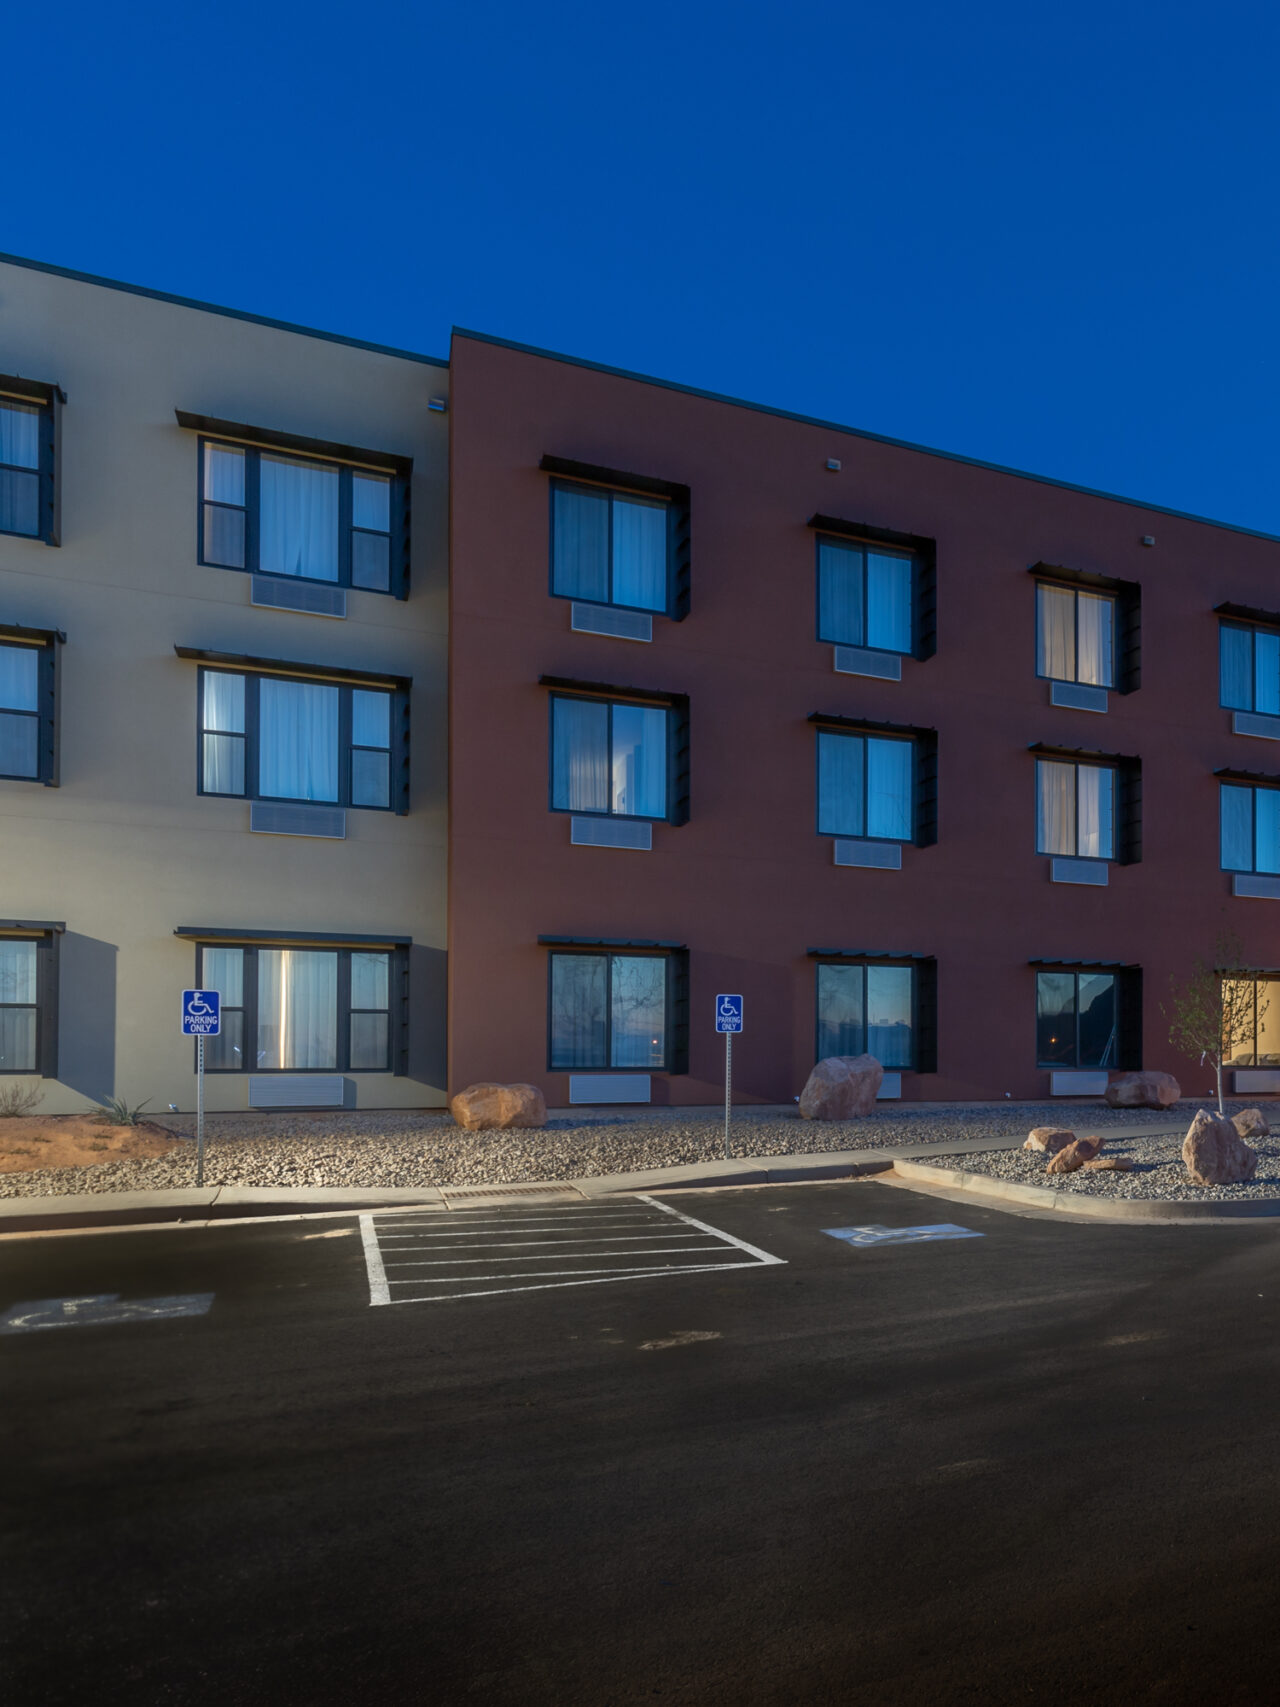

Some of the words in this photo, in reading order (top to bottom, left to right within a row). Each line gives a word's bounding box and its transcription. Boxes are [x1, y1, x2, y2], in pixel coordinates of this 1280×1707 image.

[185, 1015, 217, 1024] PARKING
[718, 1016, 740, 1024] PARKING
[190, 1024, 211, 1032] ONLY
